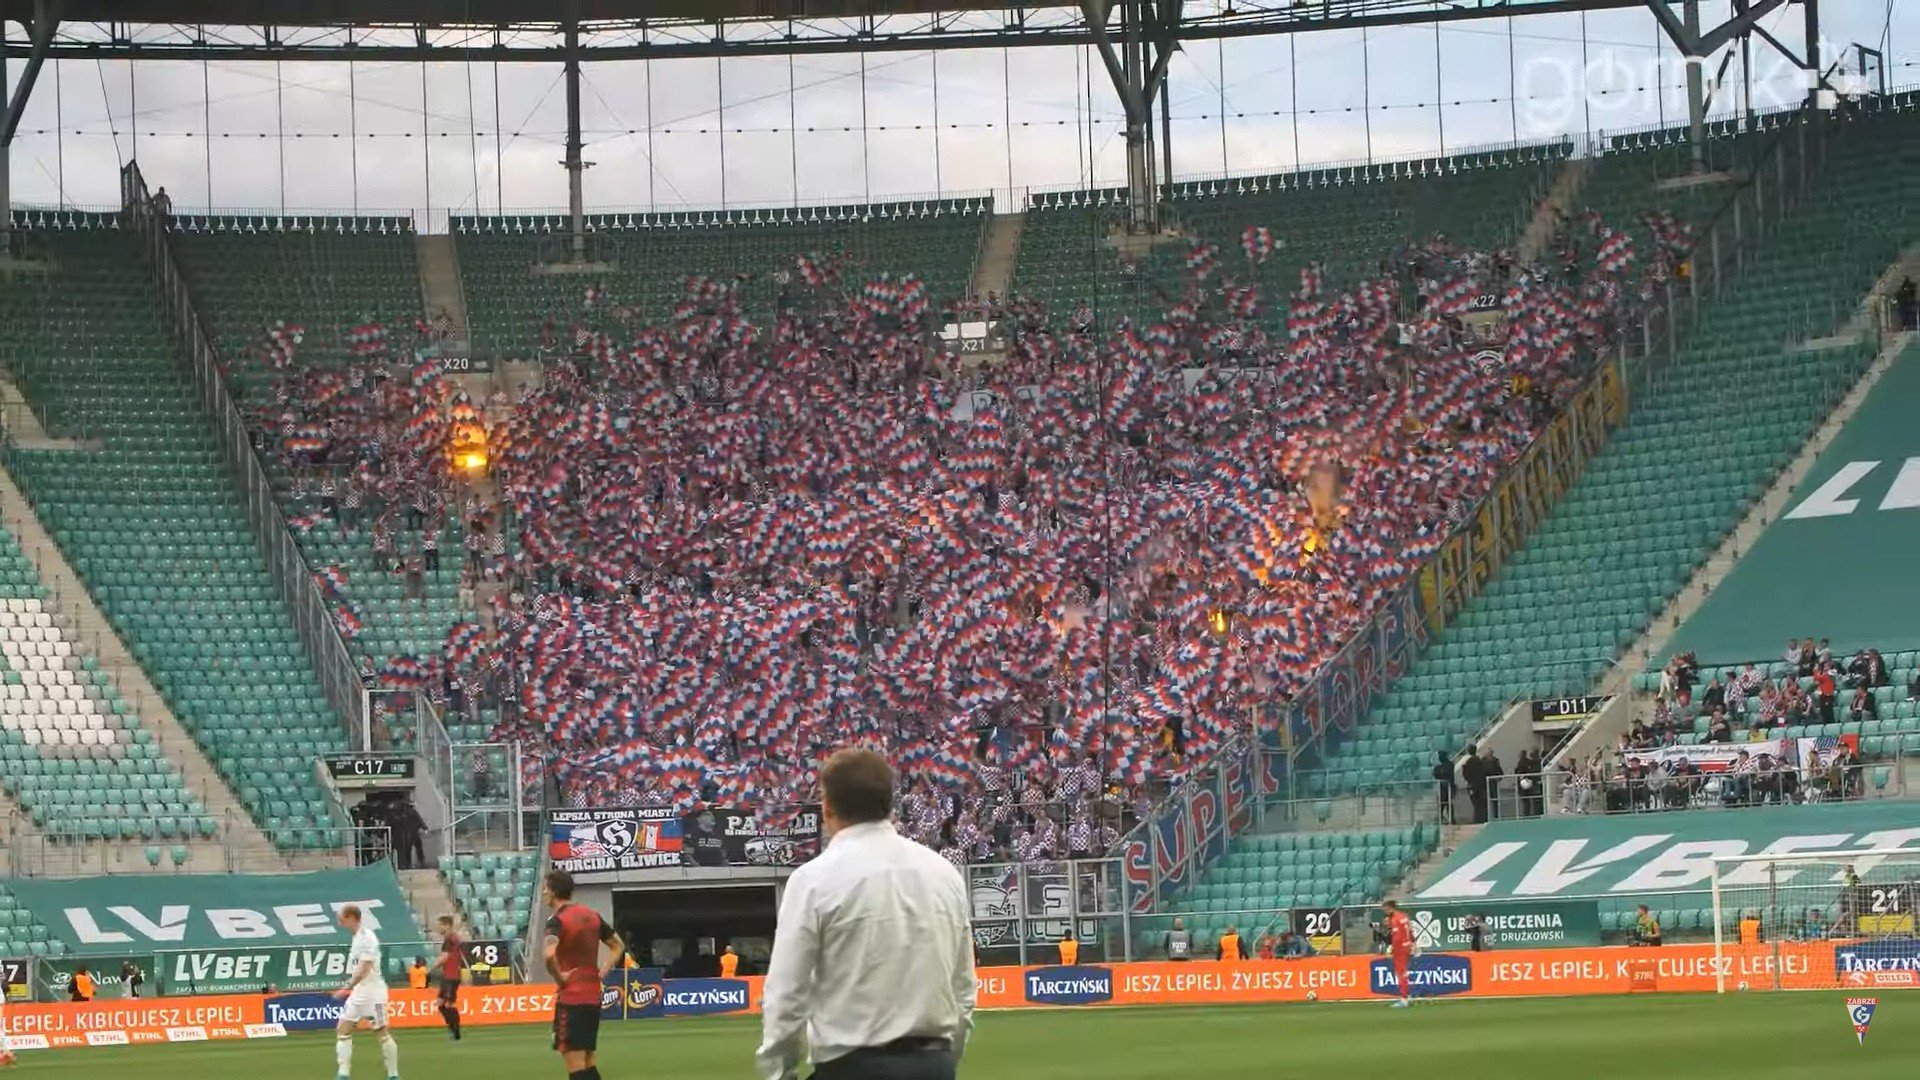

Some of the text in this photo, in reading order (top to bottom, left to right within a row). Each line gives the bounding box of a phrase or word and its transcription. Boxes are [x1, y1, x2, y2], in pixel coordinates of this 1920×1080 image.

[962, 339, 985, 351] X21
[444, 358, 469, 370] X20
[1560, 699, 1587, 714] D11
[354, 760, 384, 774] C17
[552, 808, 674, 821] LEPSZA STRONA MIAST
[1871, 889, 1899, 913] 21
[1305, 913, 1331, 934] 20
[1501, 930, 1564, 942] DRUŻKOWSKI
[1123, 975, 1161, 992] JESZ
[1231, 969, 1296, 991] ŻYJESZ
[1299, 969, 1357, 988] LEPIEJ
[1375, 966, 1468, 987] TACZYŃSKI
[1490, 963, 1533, 981] JESZ
[1029, 976, 1110, 996] TARCZYŃSKI
[481, 994, 554, 1014] ŻYJESZ
[76, 1008, 181, 1030] KIBICUJESZ
[186, 1006, 243, 1025] LEPIEJ
